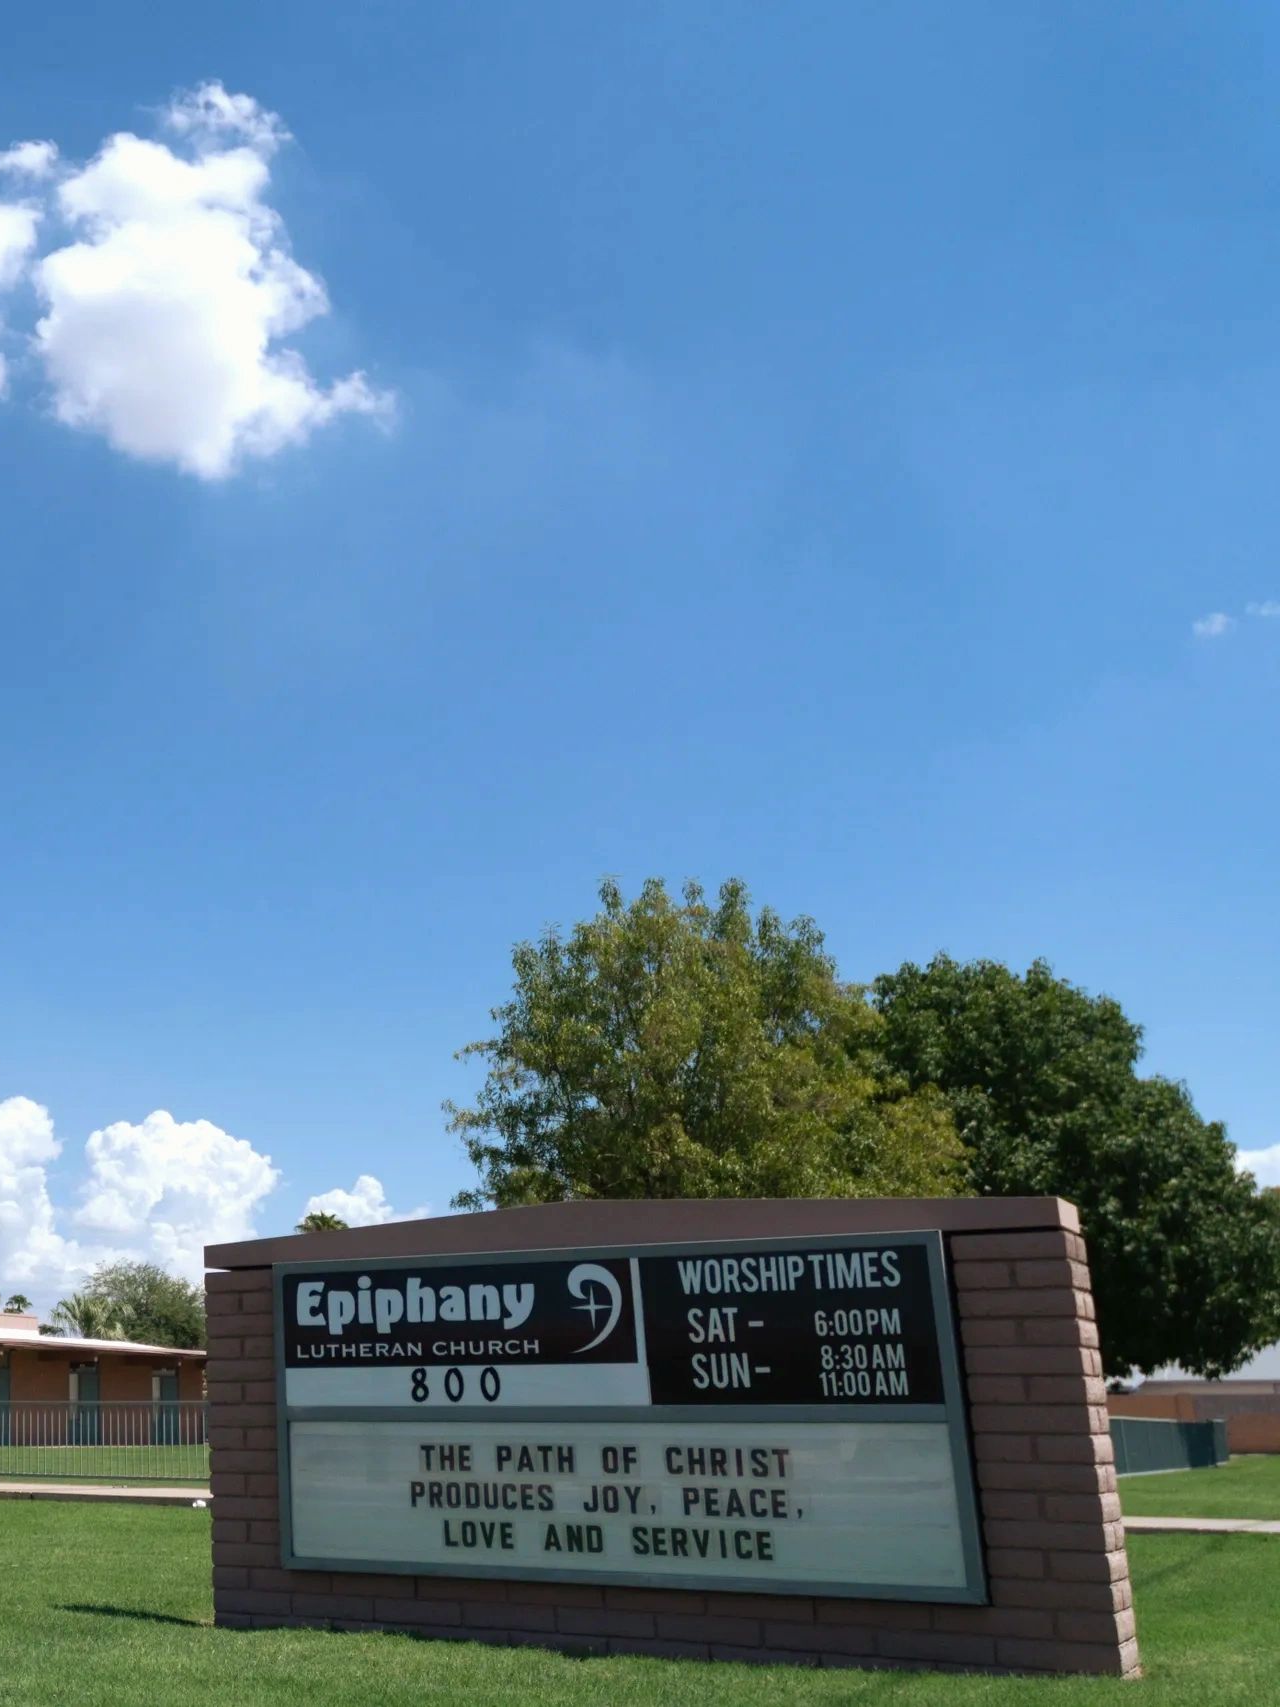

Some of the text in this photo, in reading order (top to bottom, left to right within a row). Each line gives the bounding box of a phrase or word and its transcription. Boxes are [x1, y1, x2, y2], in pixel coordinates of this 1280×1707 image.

[677, 1251, 902, 1295] WORSHIP TIMES
[296, 1276, 536, 1335] Epiphany
[296, 1338, 540, 1359] LUTHERAN CHURCH
[410, 1366, 501, 1402] 800
[421, 1444, 791, 1478] THE PATH OF CHRIST
[410, 1481, 804, 1519] PRODUCES JOY, PEACE,
[444, 1520, 774, 1561] LOVE AND SERVICE
